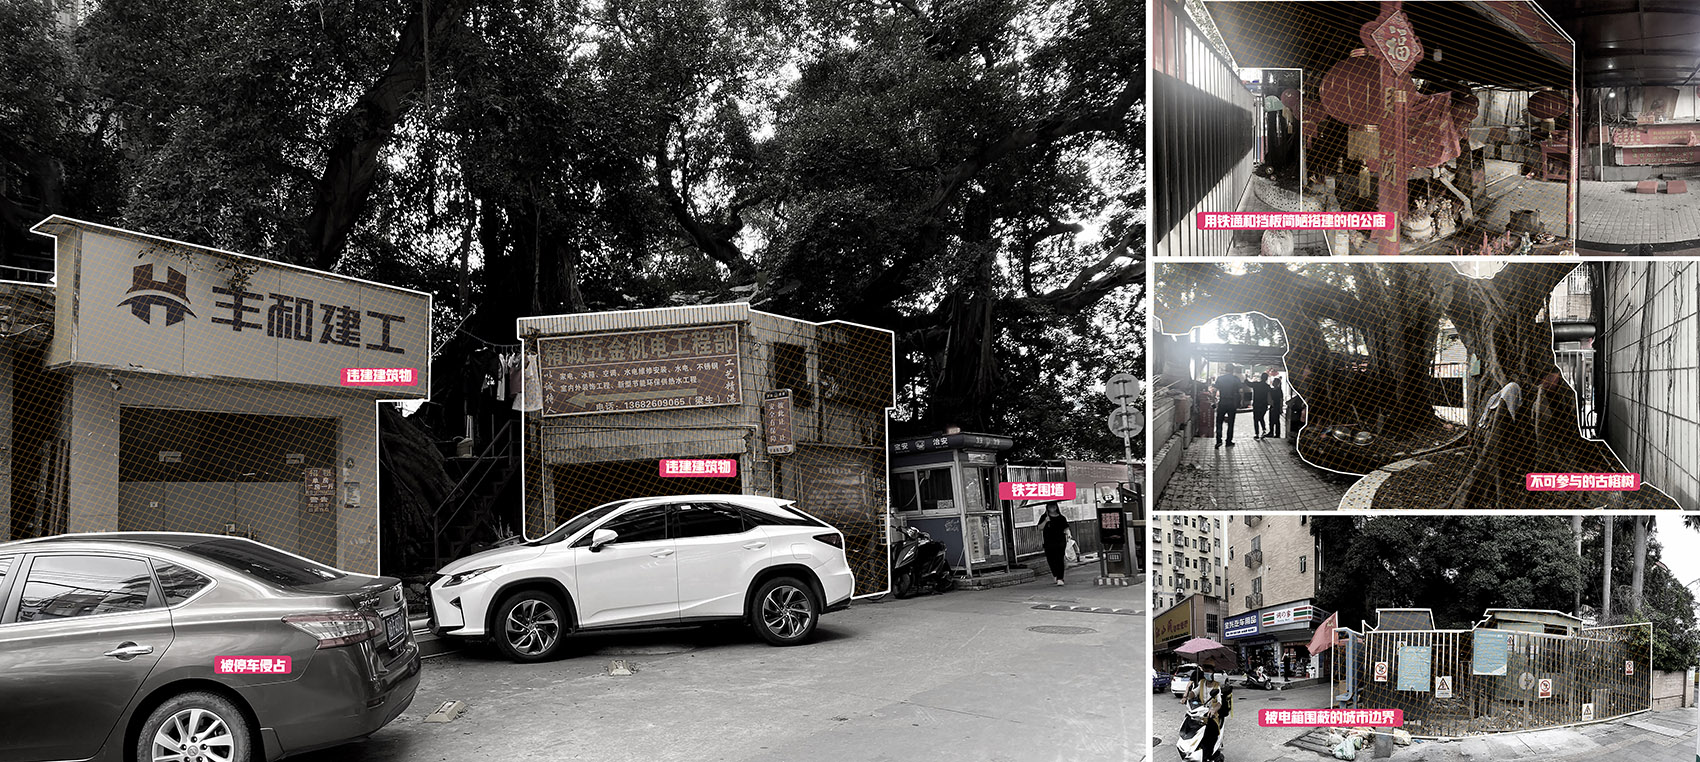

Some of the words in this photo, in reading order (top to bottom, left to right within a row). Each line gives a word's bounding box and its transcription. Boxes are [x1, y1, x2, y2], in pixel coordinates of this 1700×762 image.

[1385, 25, 1410, 62] 福
[211, 286, 405, 354] 丰和建工
[544, 329, 734, 366] 精诚五金机电工程部
